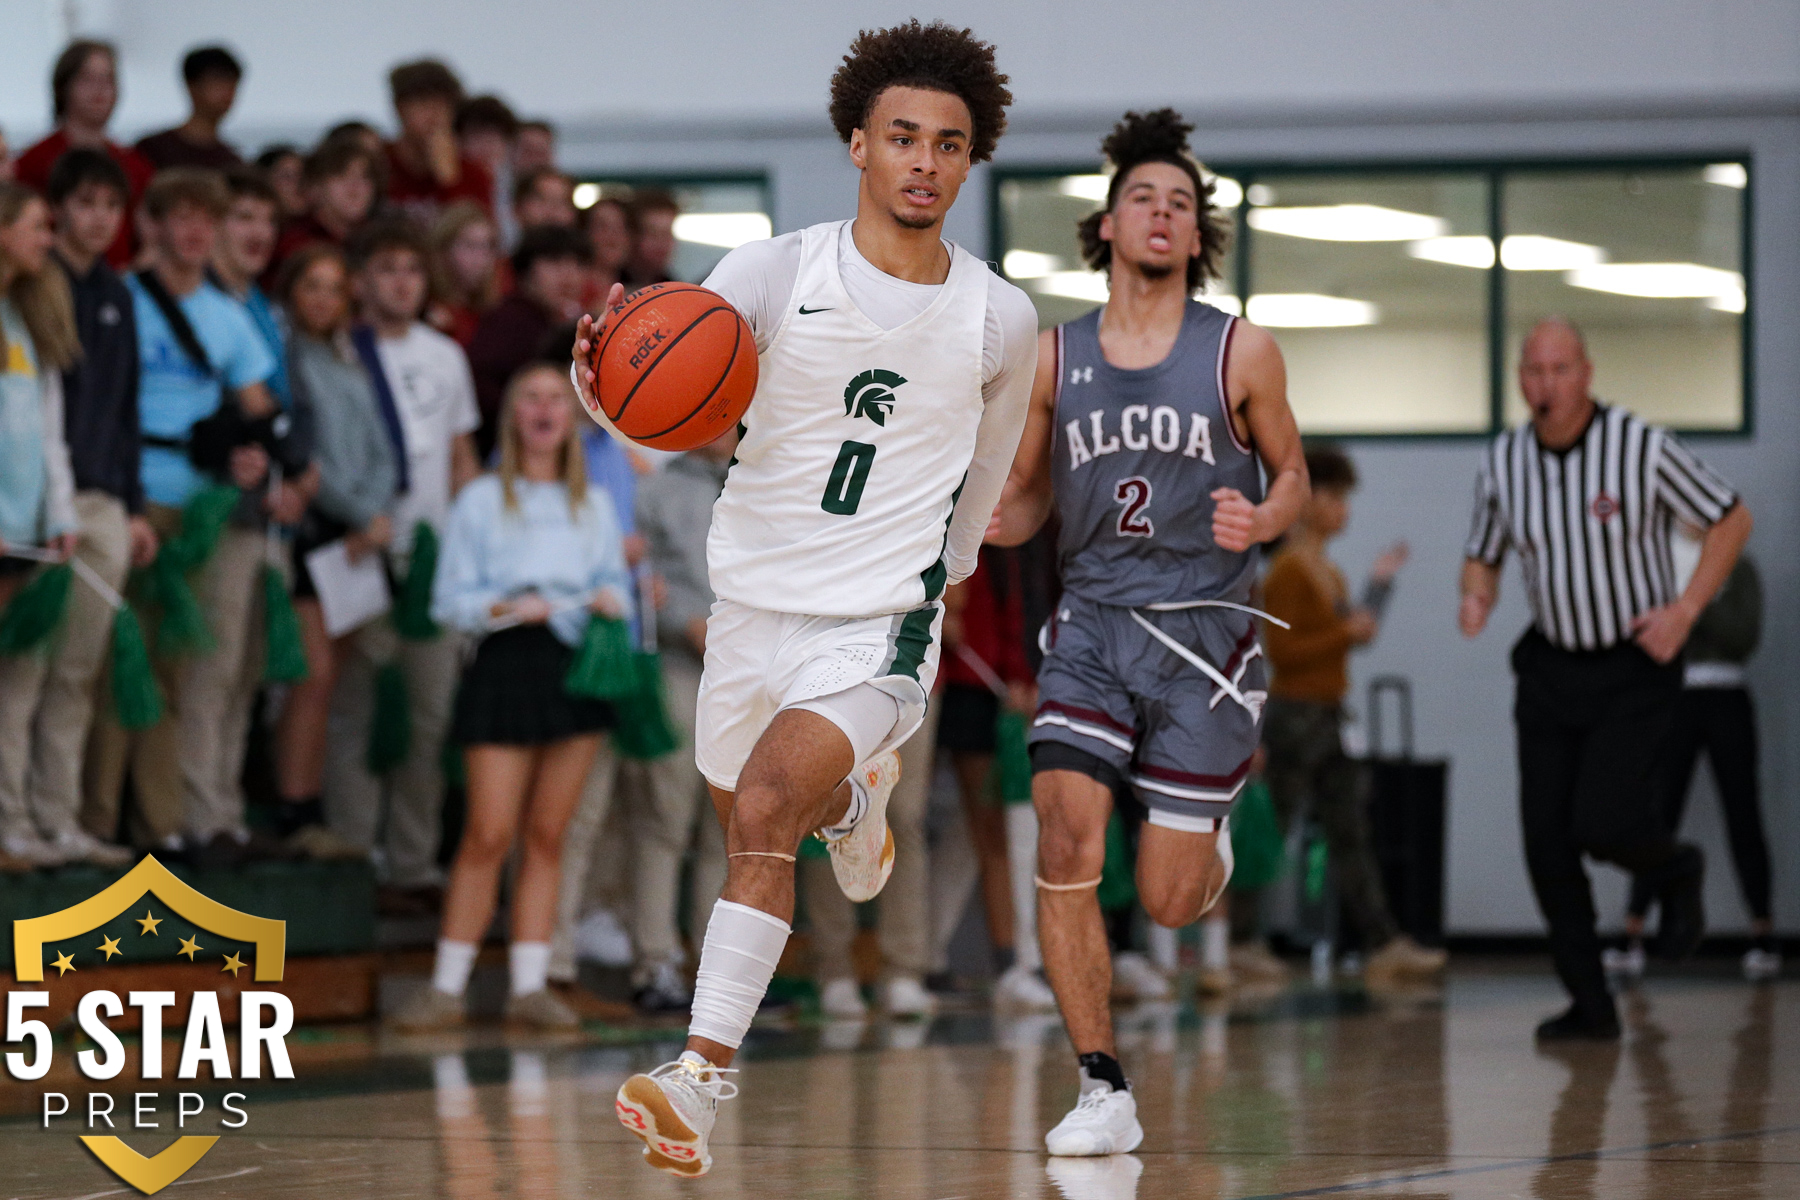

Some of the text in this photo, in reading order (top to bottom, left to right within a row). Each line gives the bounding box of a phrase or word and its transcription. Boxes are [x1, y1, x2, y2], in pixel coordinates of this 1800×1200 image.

[629, 329, 667, 370] ROCK
[635, 334, 648, 347] THE
[1065, 404, 1216, 471] ALCOA
[821, 440, 877, 515] 0
[1113, 475, 1154, 538] 2
